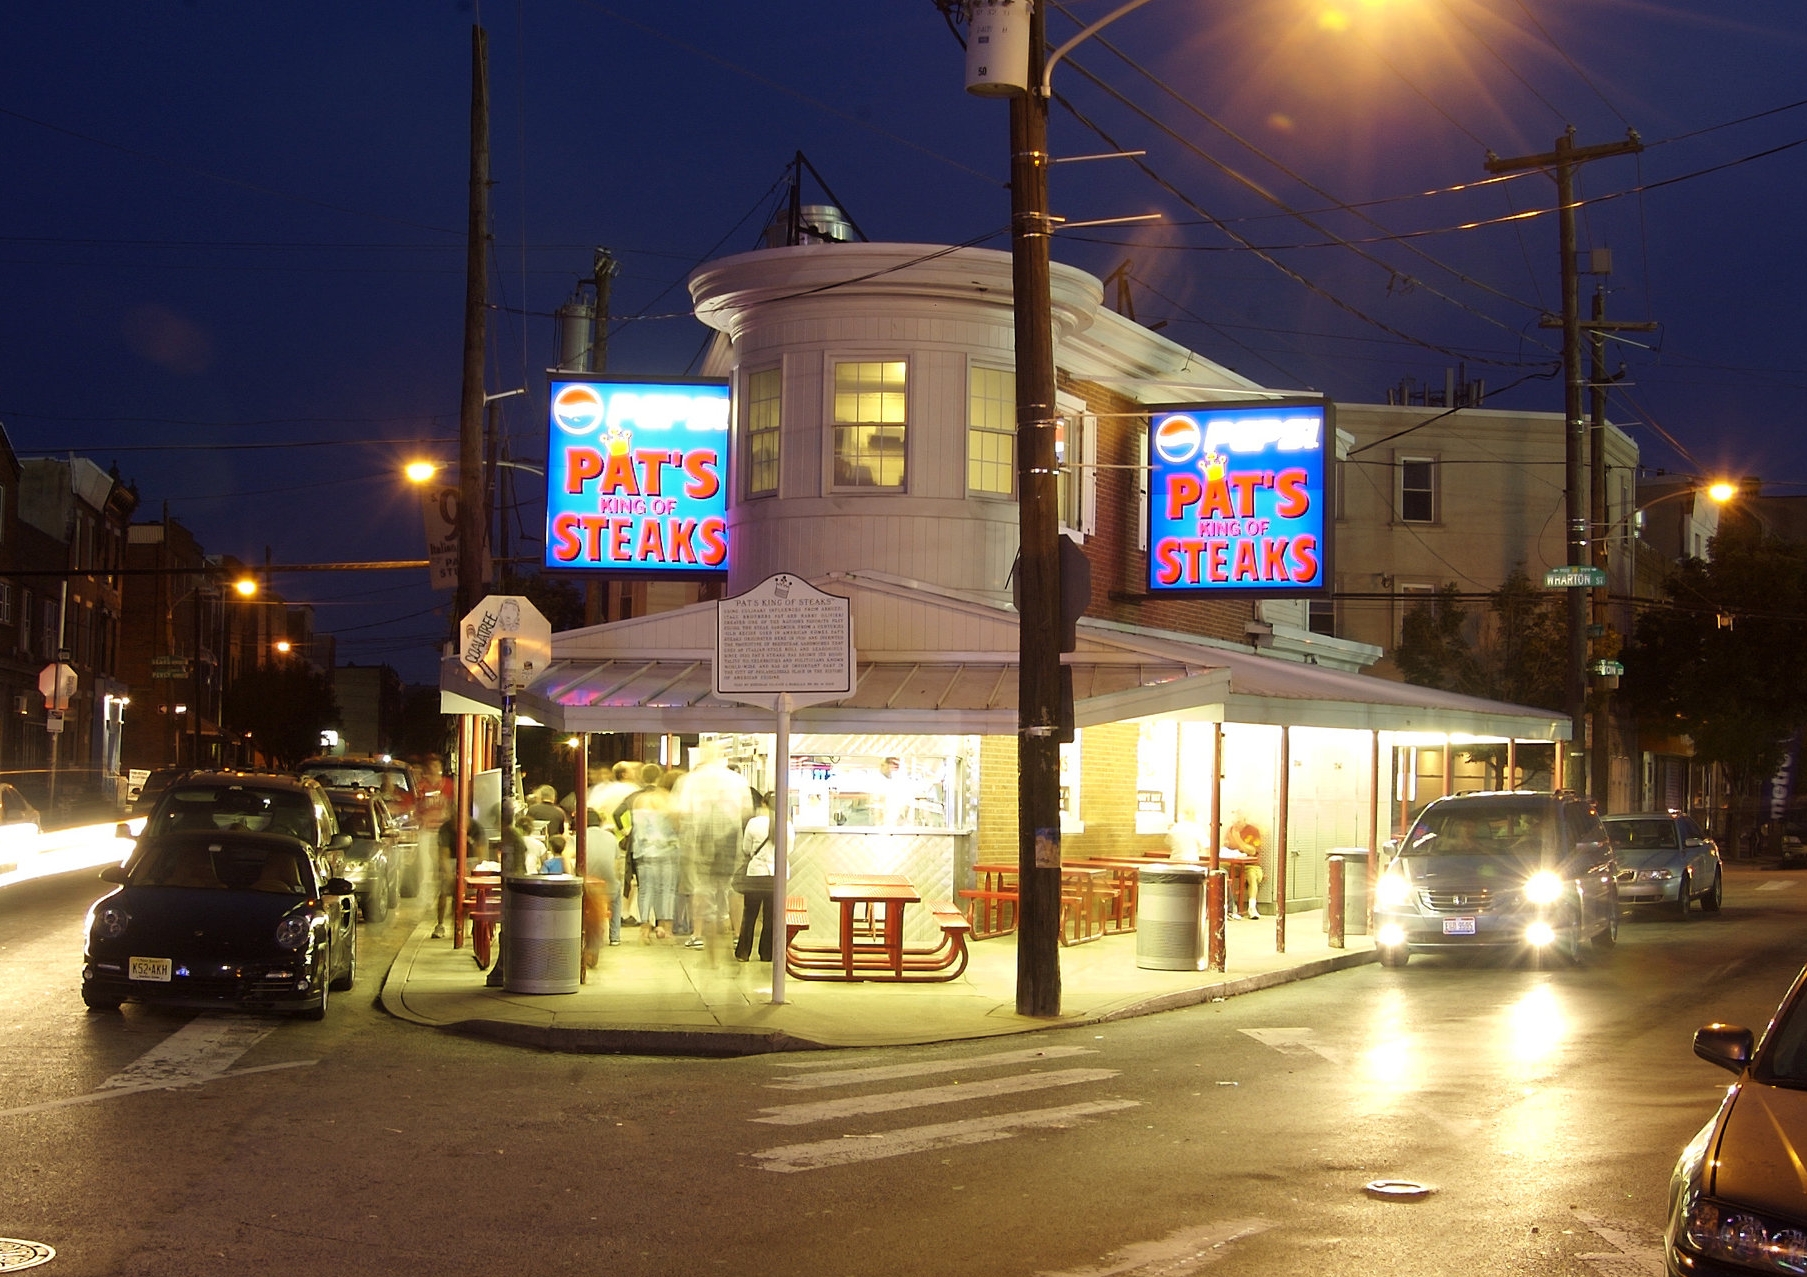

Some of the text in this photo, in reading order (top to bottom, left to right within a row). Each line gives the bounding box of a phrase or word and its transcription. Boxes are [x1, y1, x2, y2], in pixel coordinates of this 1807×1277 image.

[565, 448, 719, 499] PAT'S
[1166, 469, 1309, 519] PAT'S
[600, 498, 678, 515] KING OF
[1199, 520, 1270, 537] KING OF
[554, 513, 728, 565] STEAKS
[1158, 535, 1318, 584] STEAKS
[1547, 574, 1591, 586] WHARTON
